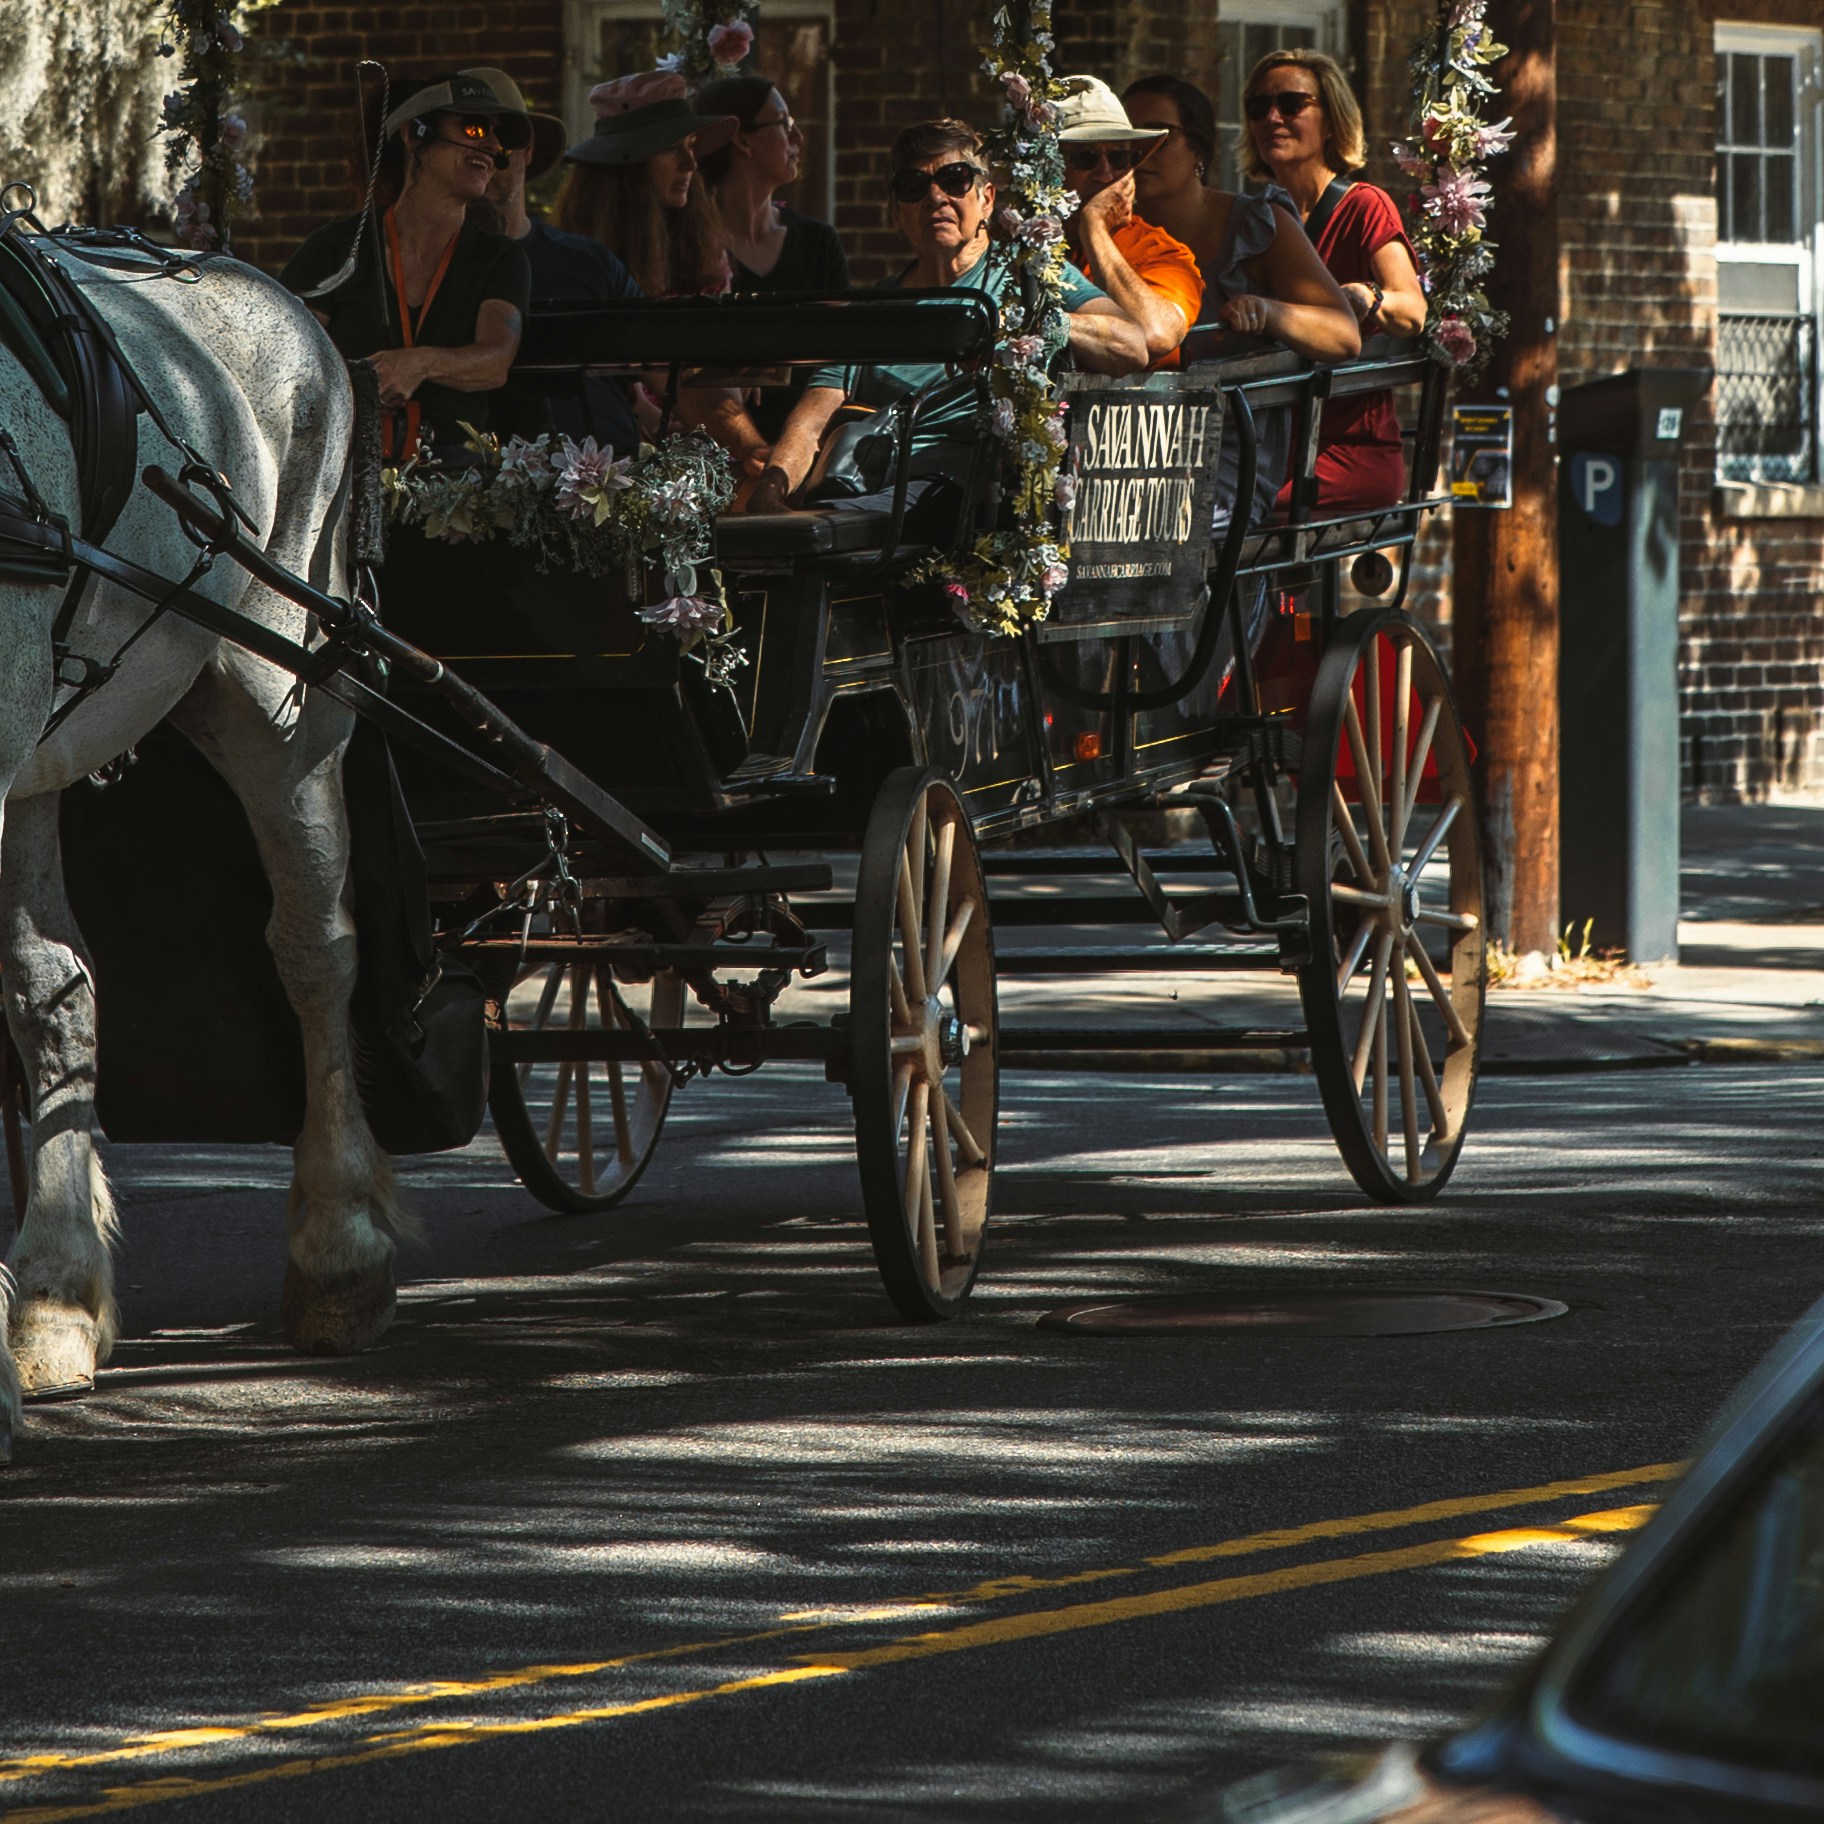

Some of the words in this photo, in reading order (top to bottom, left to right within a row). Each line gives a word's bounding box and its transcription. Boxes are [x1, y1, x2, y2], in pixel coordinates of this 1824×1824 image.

[1084, 404, 1210, 470] SAVANNAH
[1069, 477, 1145, 544] CARRIAGE
[1144, 477, 1195, 542] TOURS
[1585, 460, 1615, 512] P
